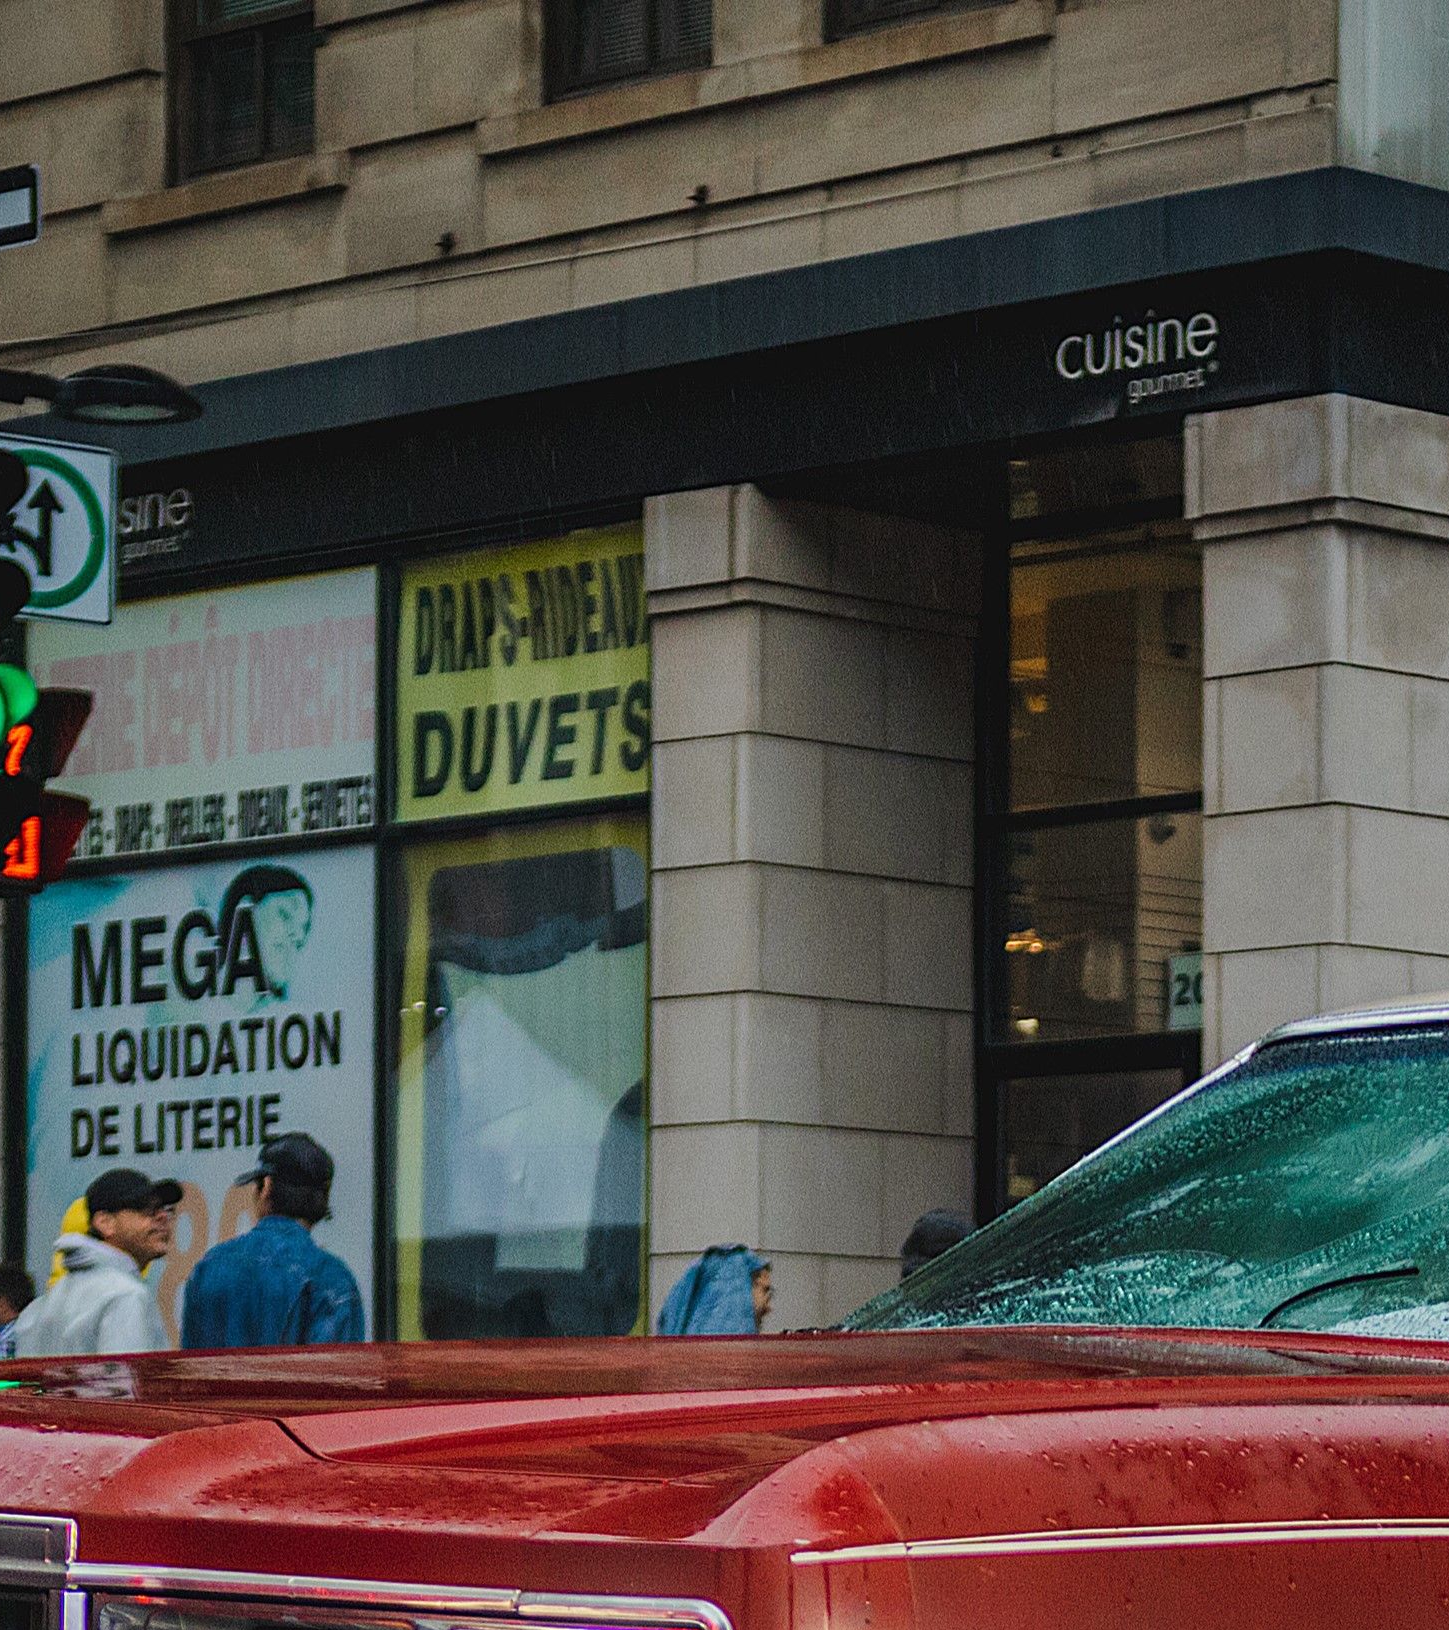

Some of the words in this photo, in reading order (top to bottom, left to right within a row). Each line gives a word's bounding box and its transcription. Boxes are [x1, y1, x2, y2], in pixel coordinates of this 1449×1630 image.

[1056, 309, 1219, 380] cuisine
[413, 679, 650, 799] DUVETS
[72, 904, 270, 1009] MEGA
[72, 1010, 342, 1087] LIQUIDATION
[71, 1104, 120, 1158] DE
[134, 1093, 282, 1153] LITERIE
